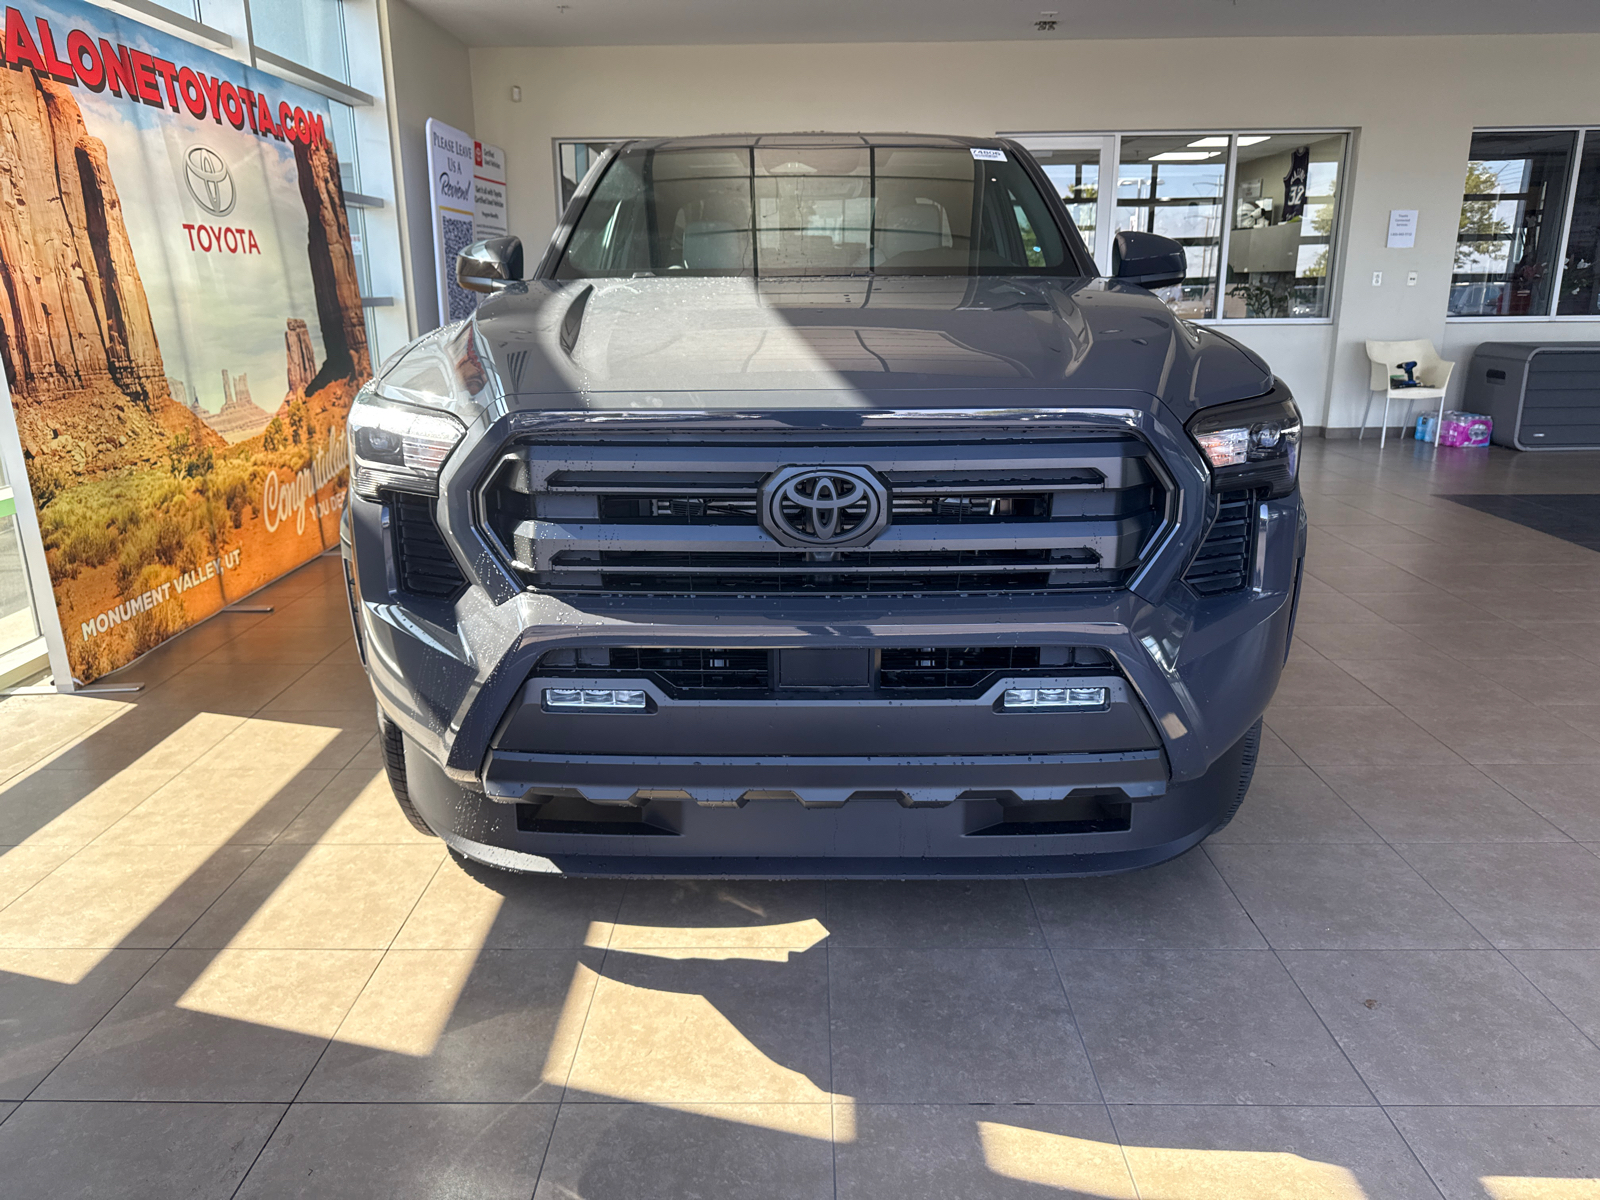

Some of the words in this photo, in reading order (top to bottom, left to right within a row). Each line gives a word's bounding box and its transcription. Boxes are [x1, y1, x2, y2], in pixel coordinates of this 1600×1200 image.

[0, 6, 329, 150] ALONETOYOTA.COM
[433, 131, 455, 154] PLEASE
[455, 140, 472, 160] LEAVE
[447, 156, 456, 173] US
[457, 161, 462, 175] A
[1288, 185, 1305, 206] 32
[182, 223, 261, 255] TOYOTA
[309, 499, 330, 521] YOU
[330, 490, 346, 511] DE
[81, 582, 171, 642] MONUMENT
[173, 557, 225, 596] VALLEY,
[224, 549, 241, 571] UT
